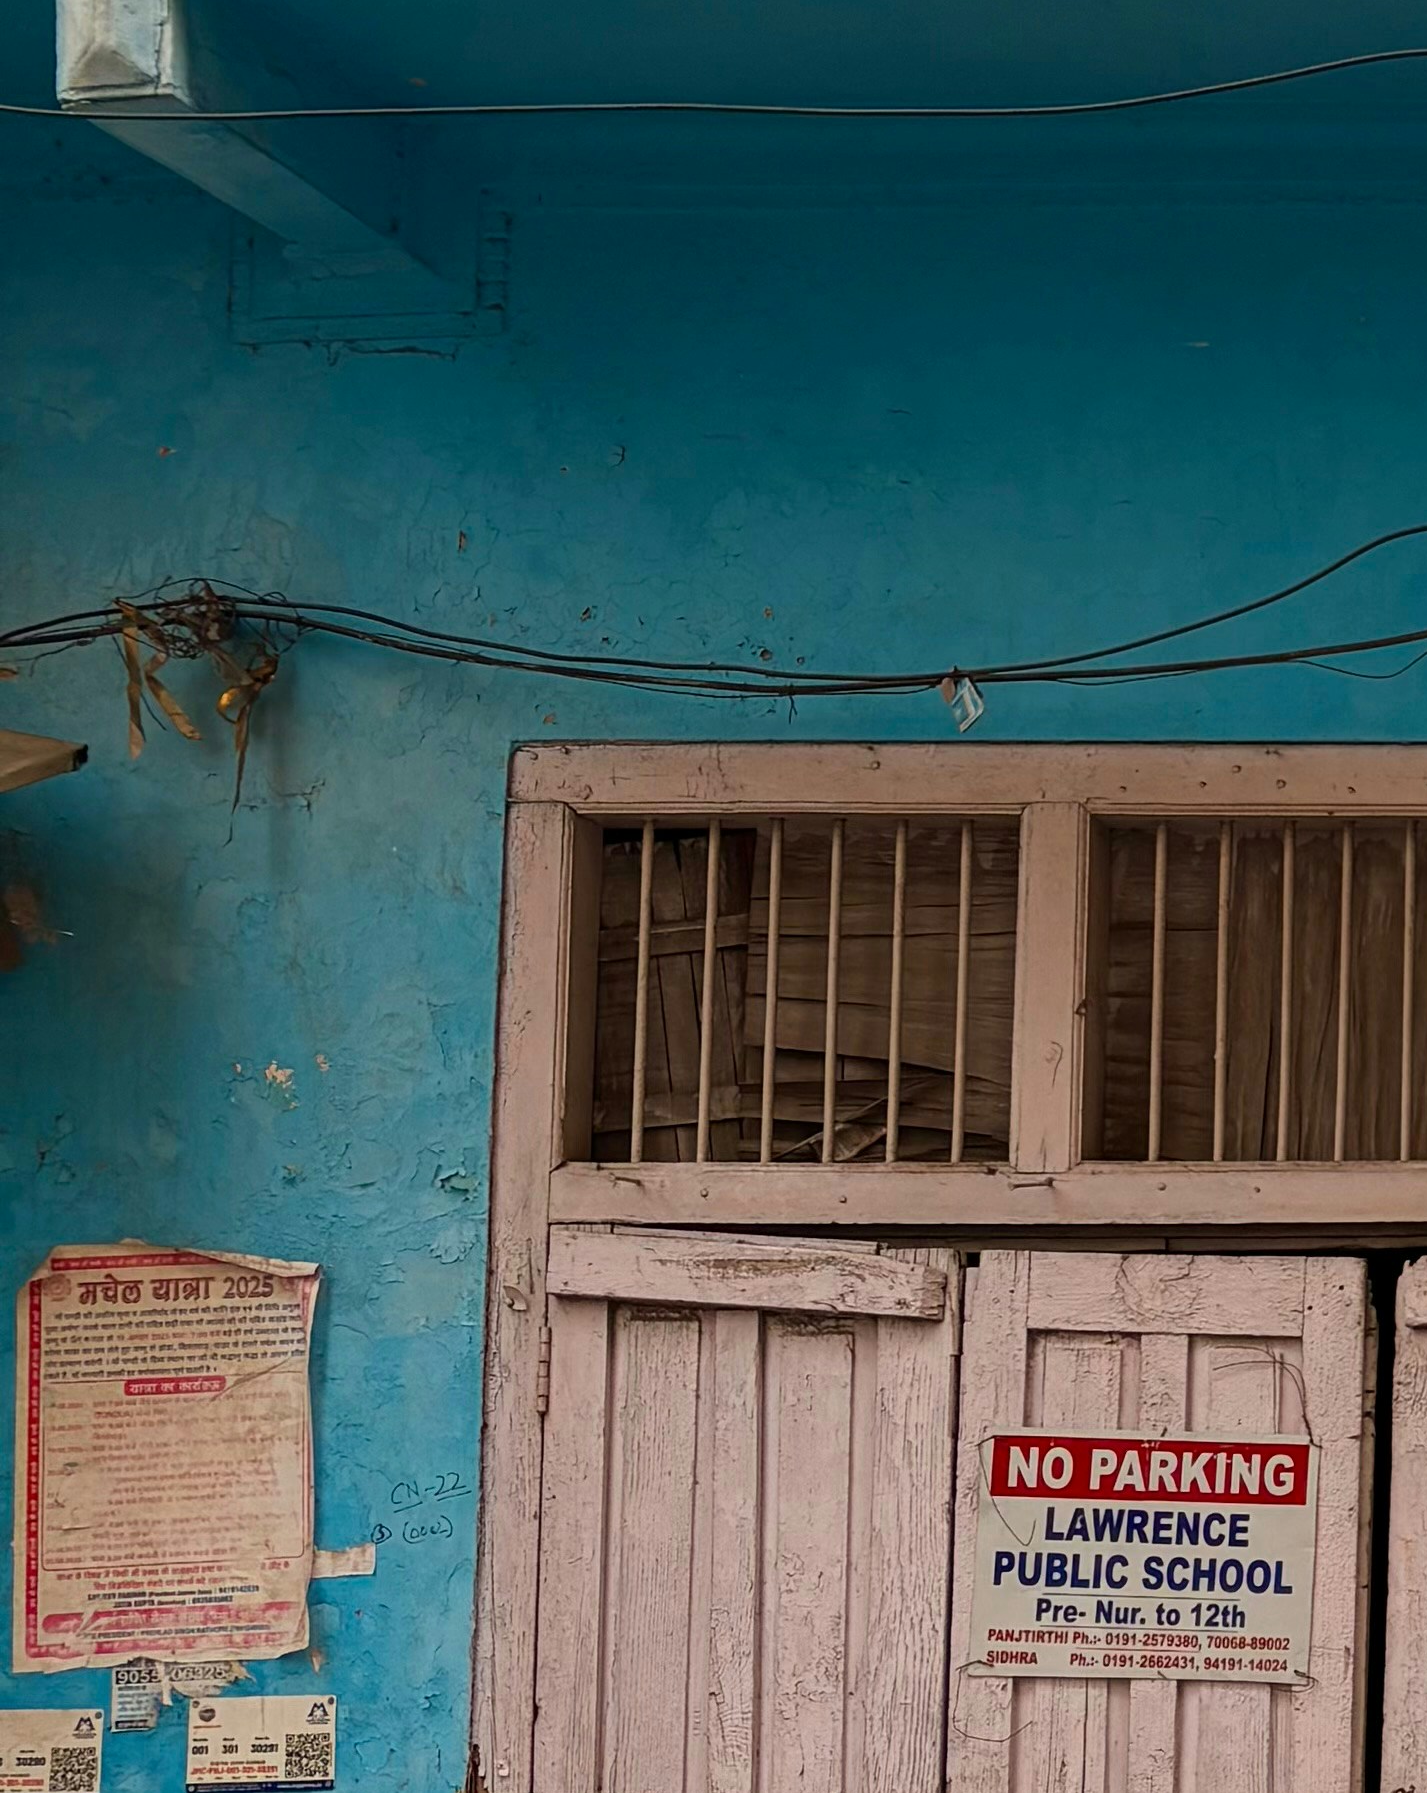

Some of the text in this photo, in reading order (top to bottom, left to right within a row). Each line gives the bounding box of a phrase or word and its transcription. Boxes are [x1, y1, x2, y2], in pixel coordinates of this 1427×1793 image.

[78, 1273, 274, 1305] मचेल यात्रा 2025
[1007, 1445, 1296, 1497] NO PARKING
[1044, 1506, 1250, 1547] LAWRENCE
[992, 1550, 1293, 1595] PUBLIC SCHOOL
[1035, 1597, 1246, 1628] Pre- Nur. to 12th
[987, 1629, 1068, 1645] PANJTIRTHI
[1105, 1632, 1202, 1651] 0191-2579380,
[1206, 1635, 1290, 1650] 70068-89002
[986, 1651, 1038, 1665] SIDHRA
[1102, 1654, 1200, 1672] 0191-2662431,
[1203, 1657, 1288, 1672] 94191-14024
[222, 1744, 238, 1755] 301
